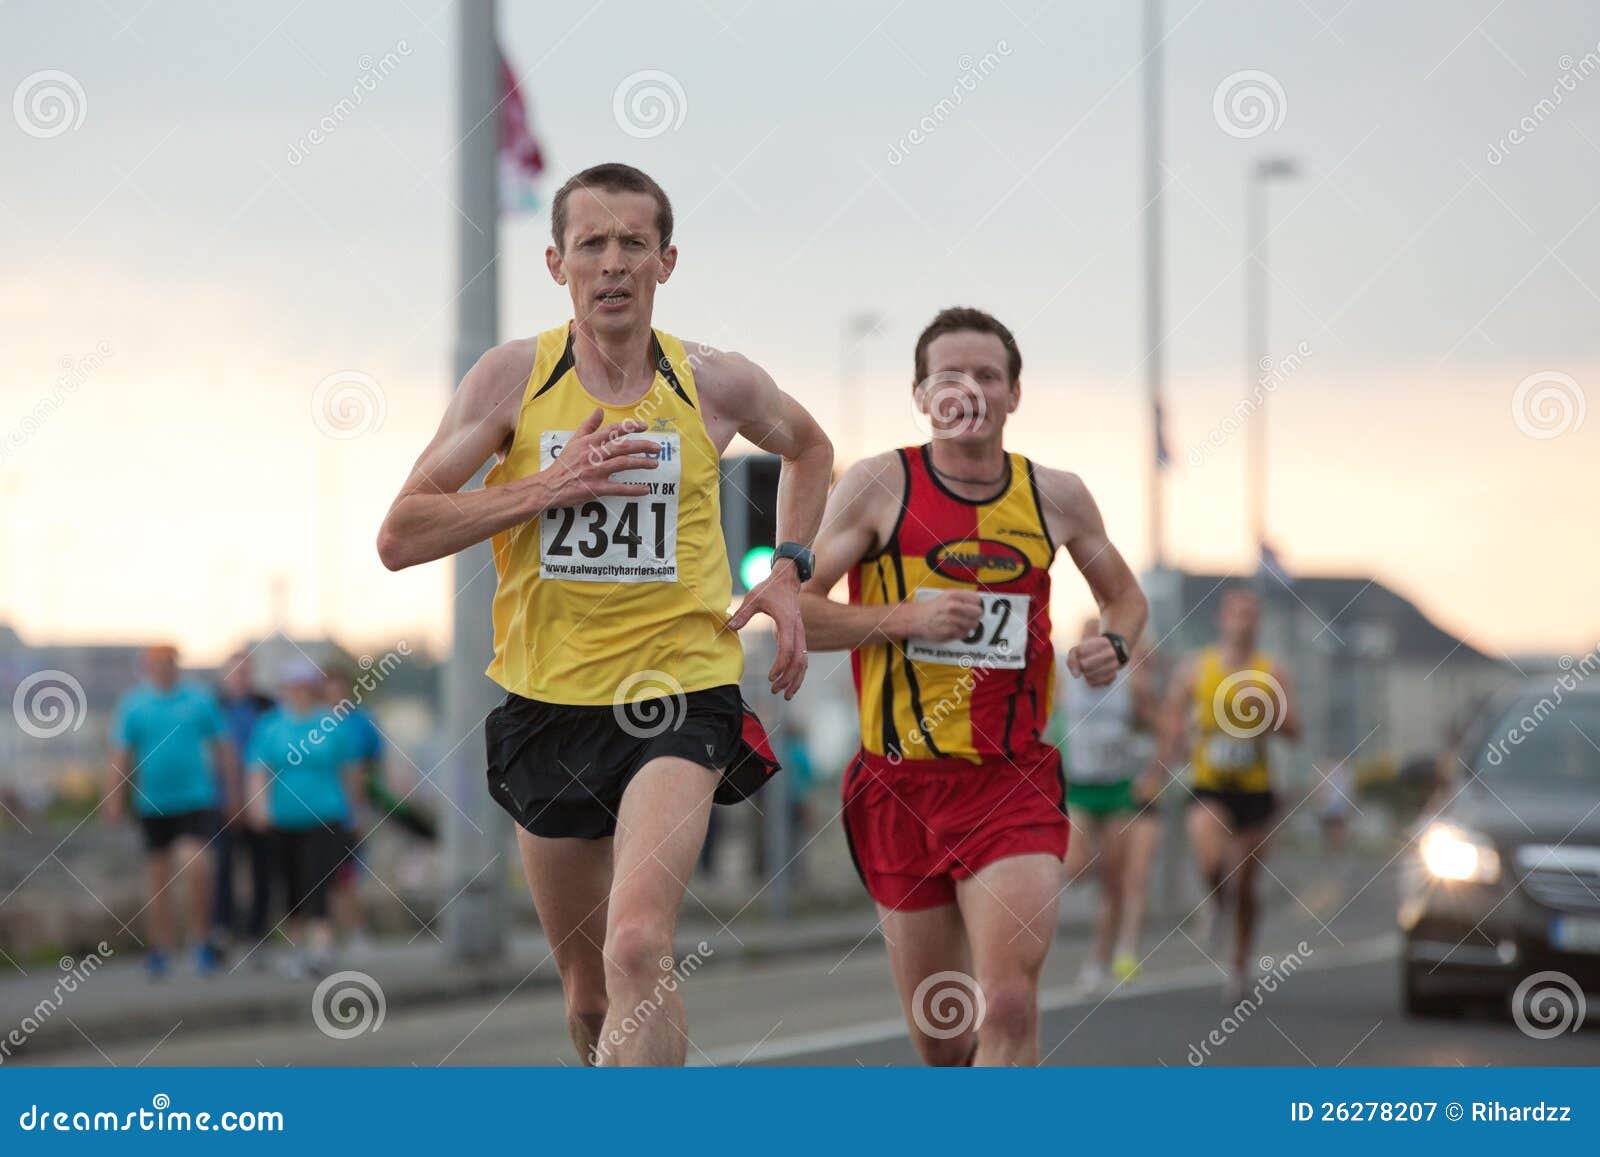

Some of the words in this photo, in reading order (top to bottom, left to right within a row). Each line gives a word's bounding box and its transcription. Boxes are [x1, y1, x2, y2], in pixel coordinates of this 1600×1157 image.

[662, 482, 676, 495] 8K
[546, 501, 667, 559] 2341
[544, 563, 675, 577] www.galwaycityharriers.com
